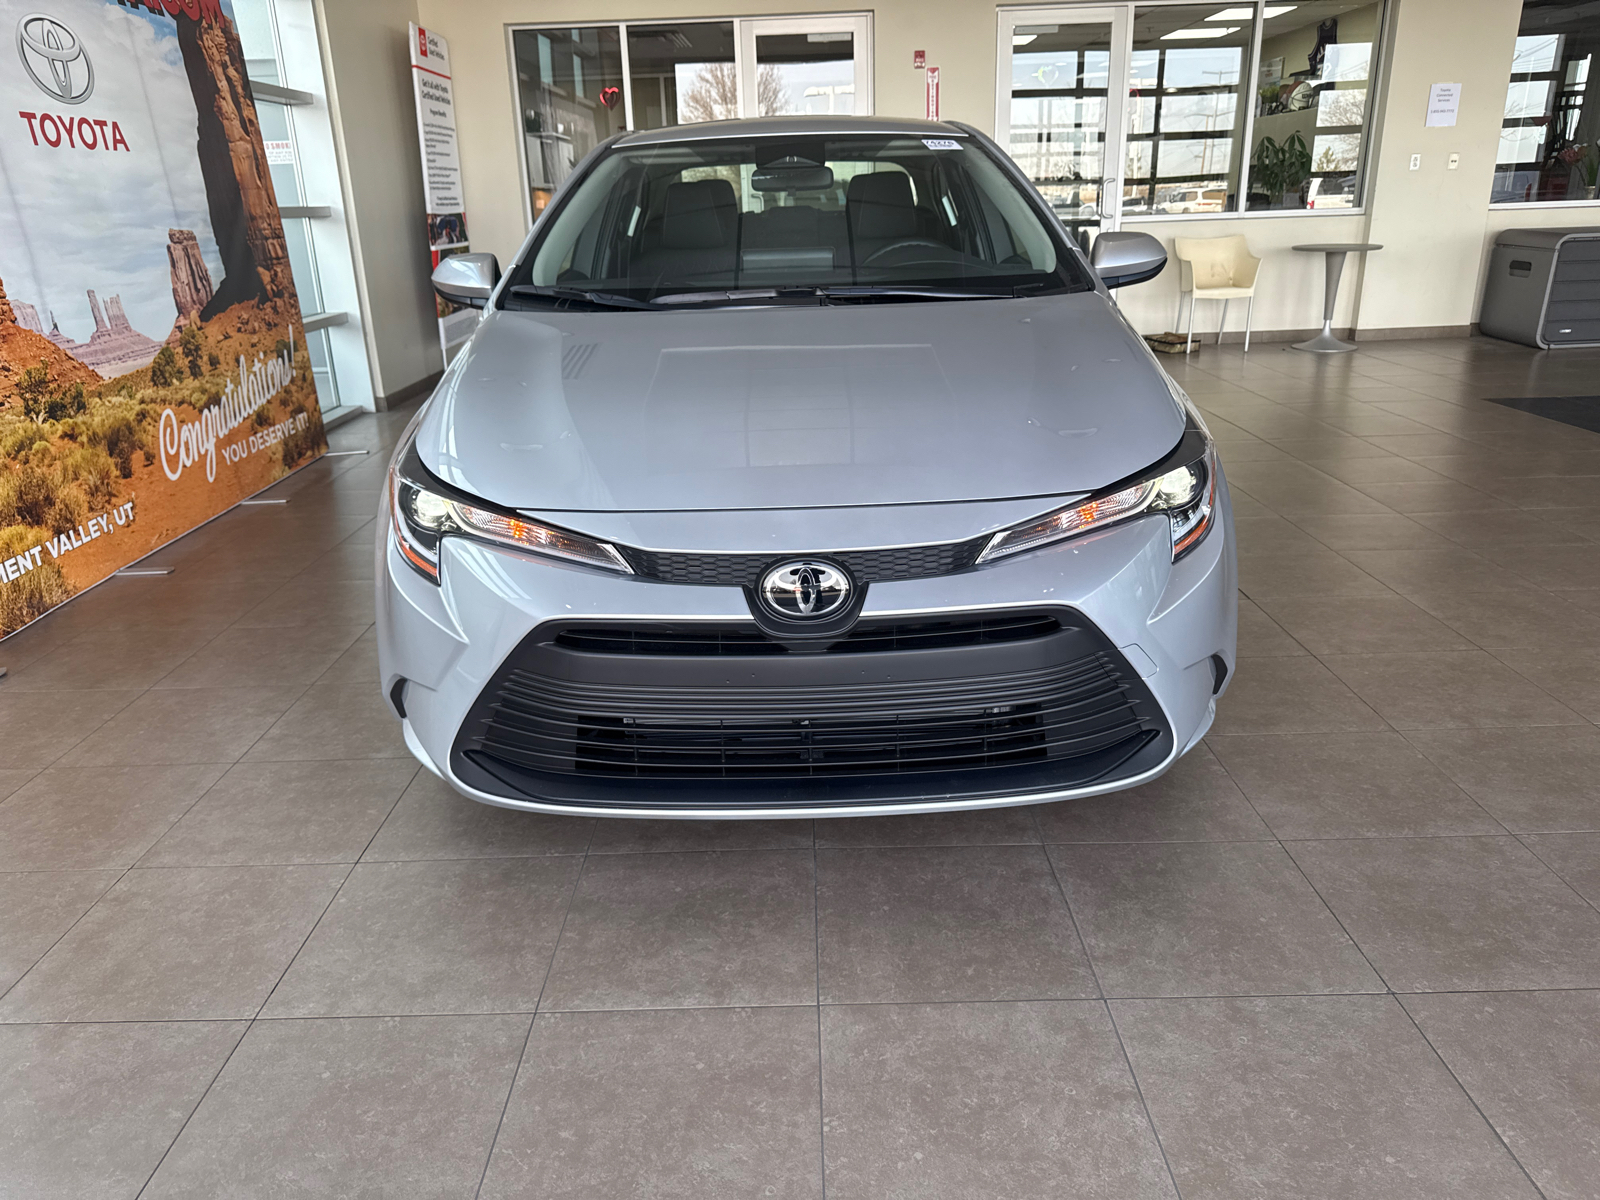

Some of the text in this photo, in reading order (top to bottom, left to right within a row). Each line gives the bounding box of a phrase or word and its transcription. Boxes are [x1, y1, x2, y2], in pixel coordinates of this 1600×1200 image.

[18, 111, 130, 152] TOYOTA
[159, 324, 296, 483] Congratulations!
[222, 412, 310, 465] YOU DESERVE IT!
[45, 513, 114, 559] VALLEY,
[113, 502, 134, 526] UT
